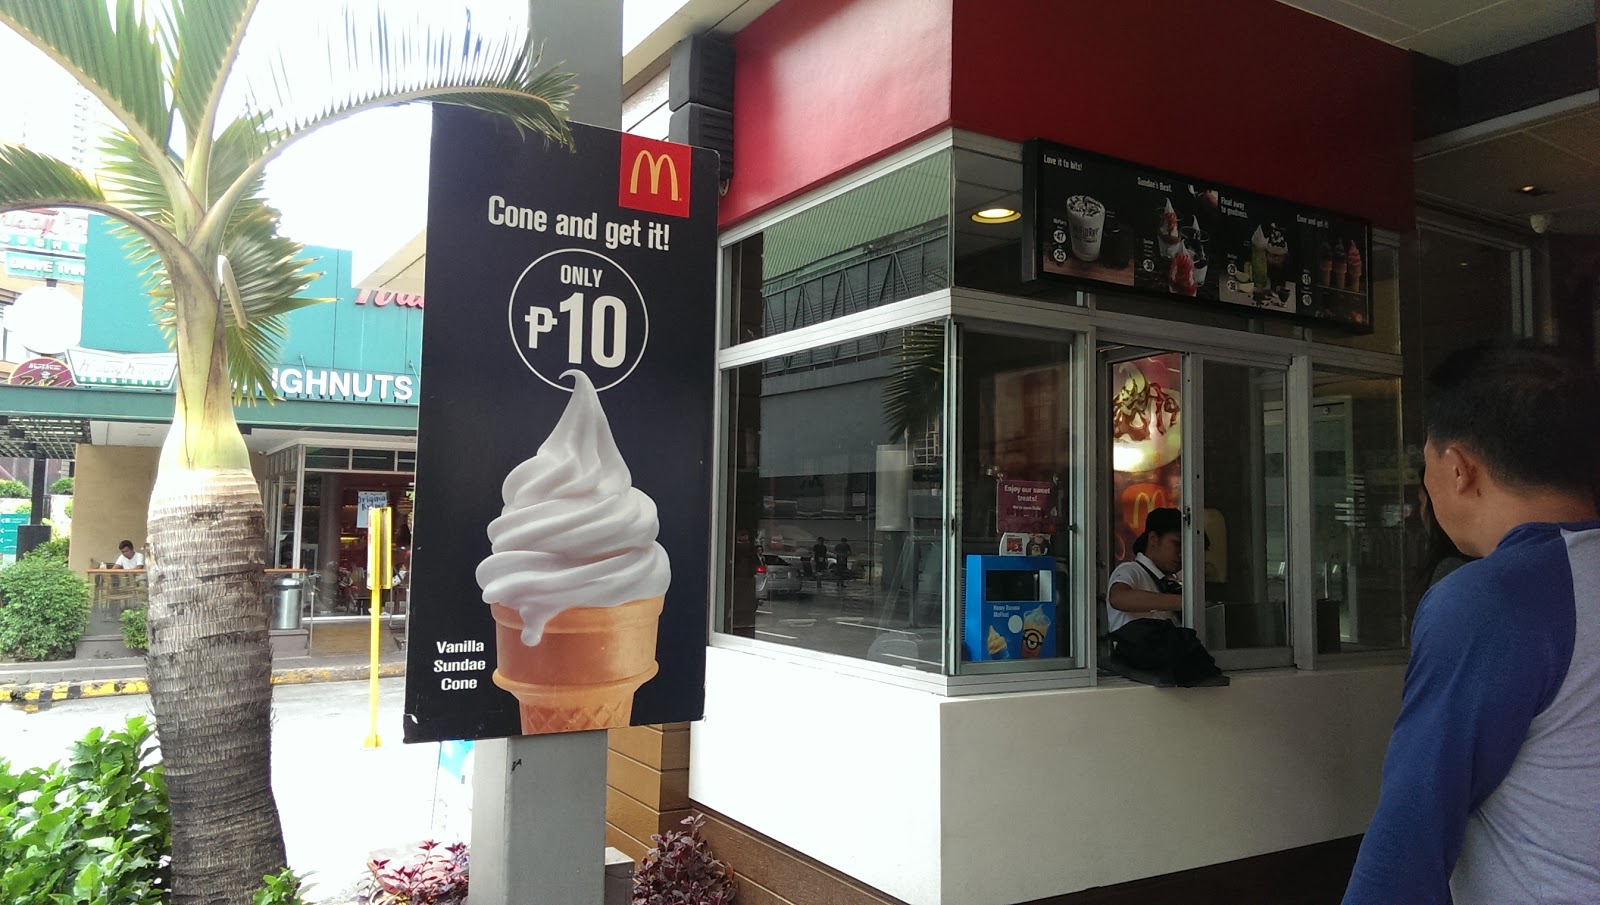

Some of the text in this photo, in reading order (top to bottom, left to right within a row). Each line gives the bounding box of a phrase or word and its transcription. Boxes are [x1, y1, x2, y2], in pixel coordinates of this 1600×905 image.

[1043, 154, 1083, 172] Love it to bits!
[488, 195, 671, 251] Cone and get it!
[10, 257, 53, 274] DRIVE
[560, 264, 603, 288] ONLY
[1004, 484, 1021, 494] Enjoy
[1033, 486, 1051, 495] sweet
[1017, 495, 1038, 503] treats!
[436, 640, 485, 654] Vanilla
[433, 658, 486, 673] Sundae
[440, 677, 478, 691] Cone
